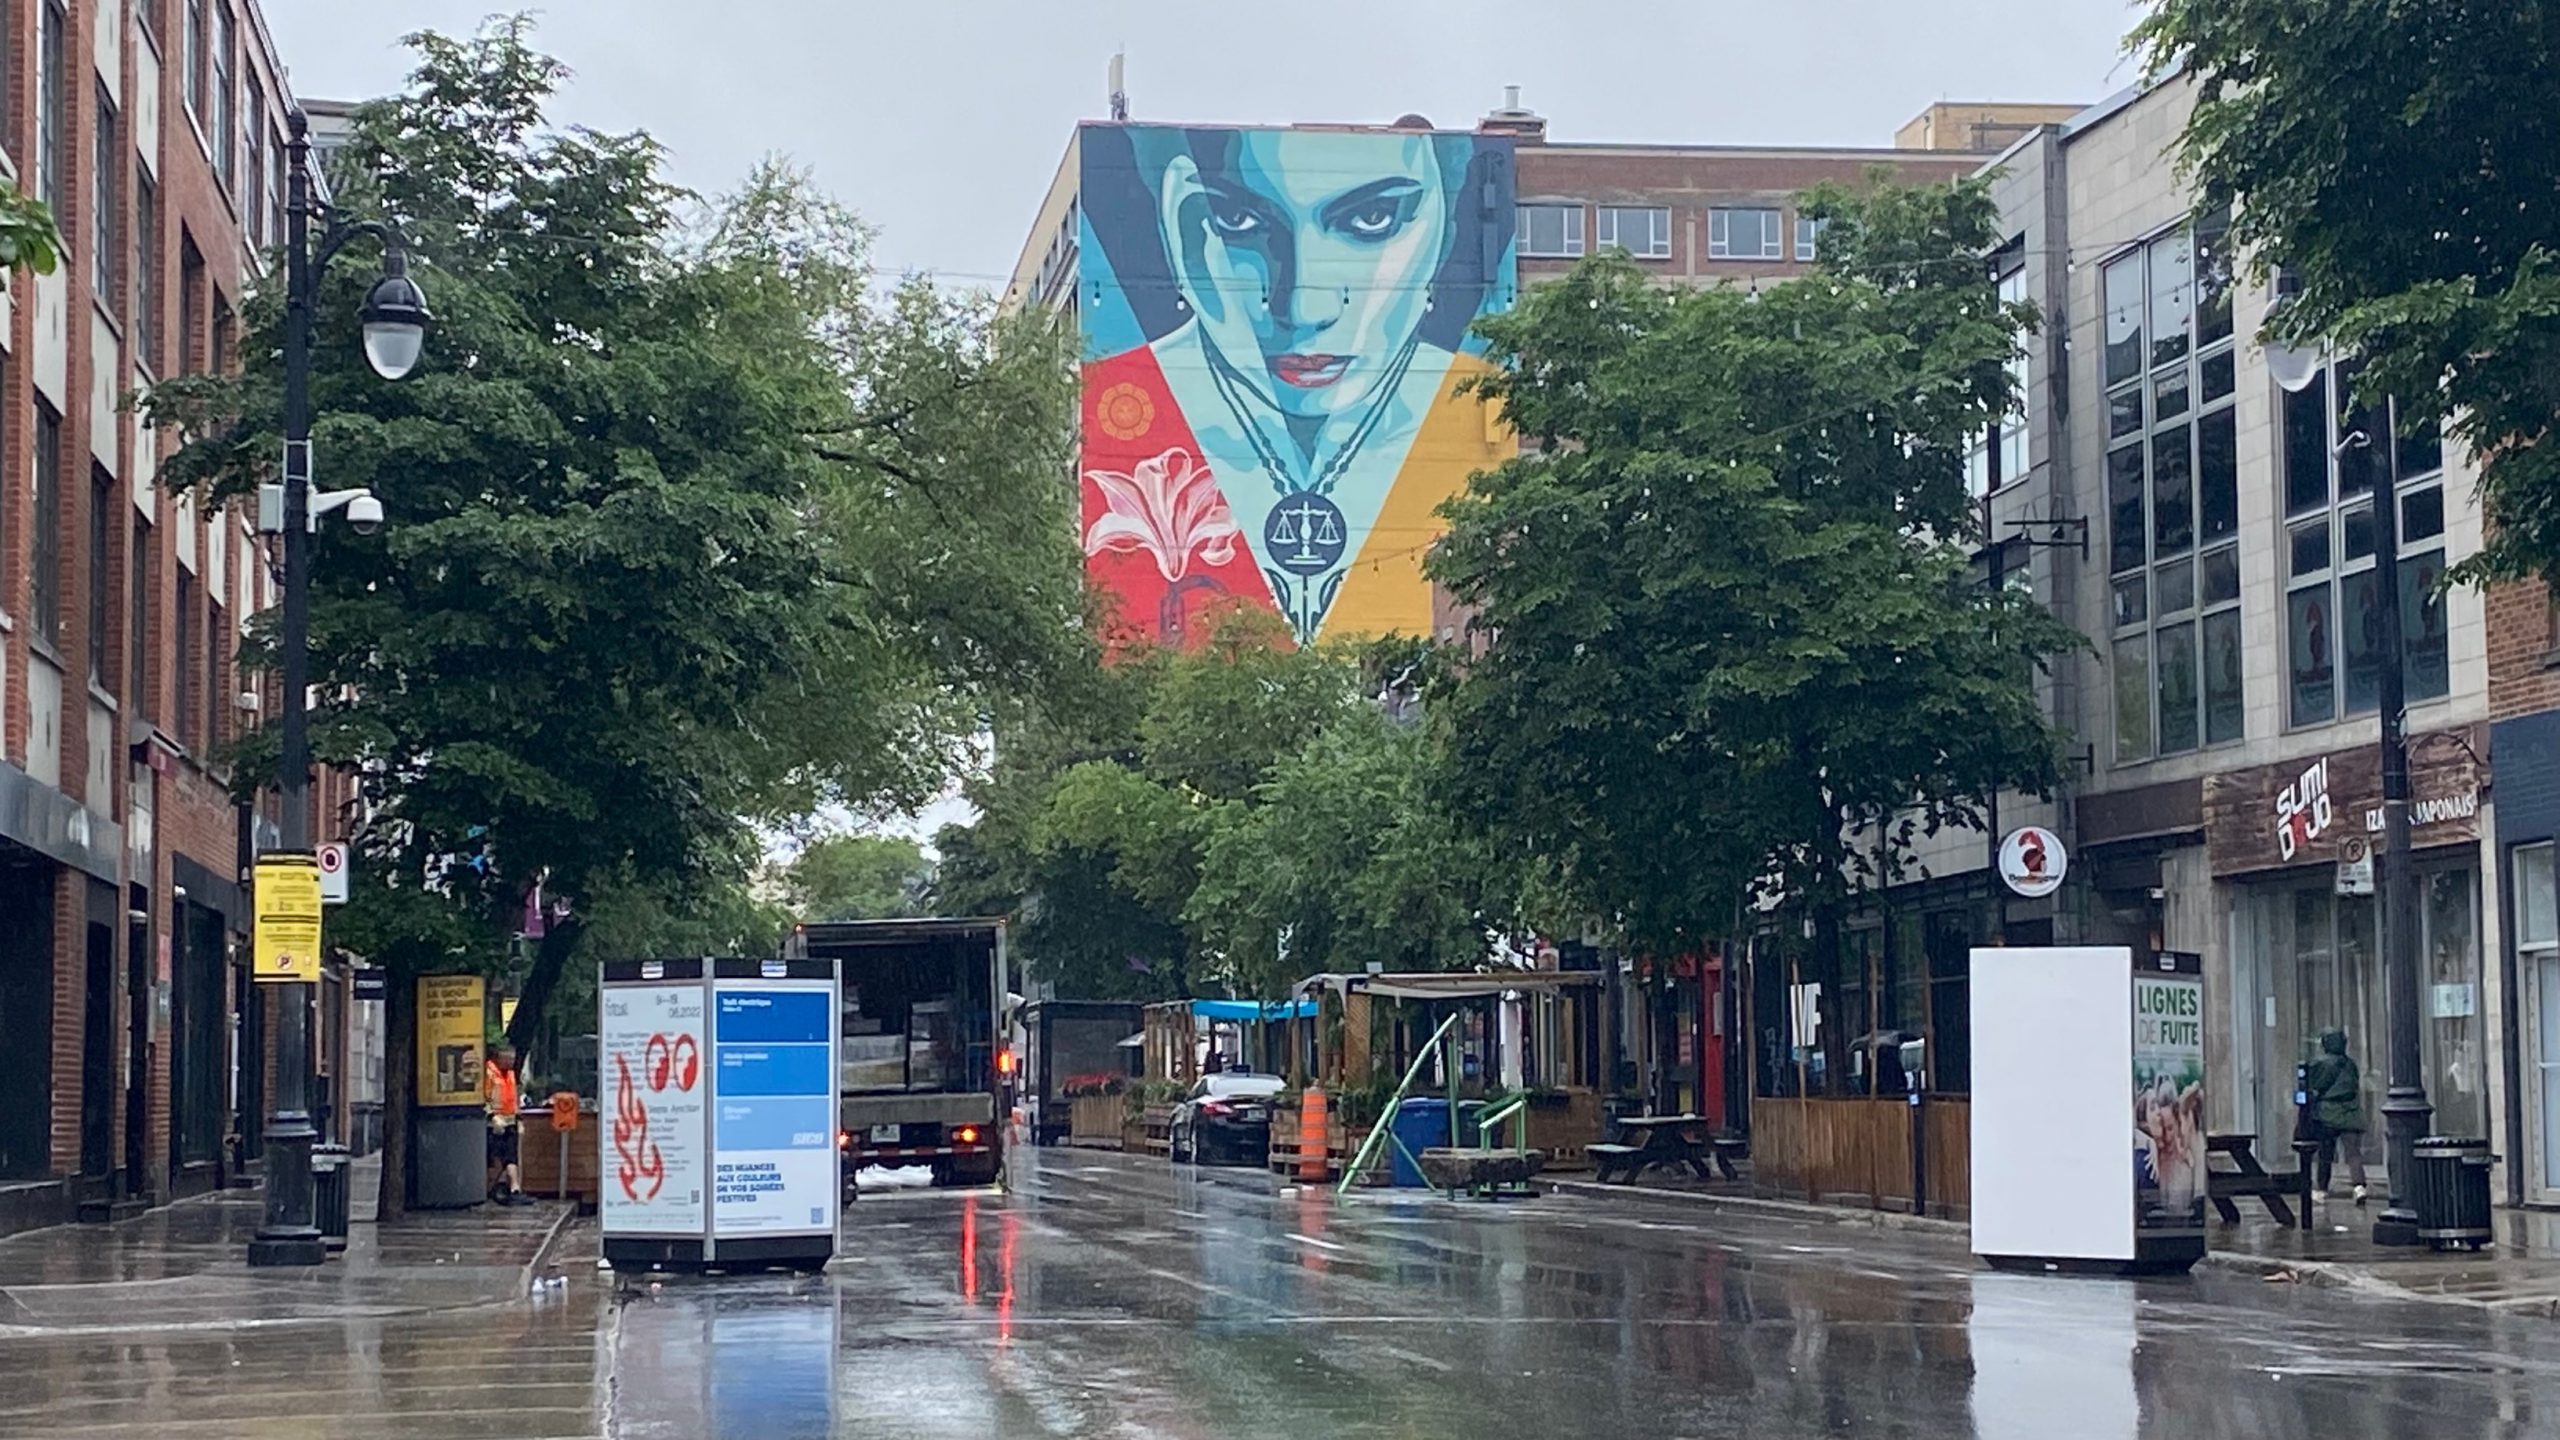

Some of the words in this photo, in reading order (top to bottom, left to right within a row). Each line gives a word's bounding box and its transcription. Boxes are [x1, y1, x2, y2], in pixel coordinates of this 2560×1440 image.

[2277, 756, 2328, 828] SUMI
[2416, 794, 2475, 824] JAPONAIS
[2138, 985, 2198, 1016] LIGNES
[2139, 1019, 2156, 1045] DE
[2161, 1021, 2199, 1046] FUITE
